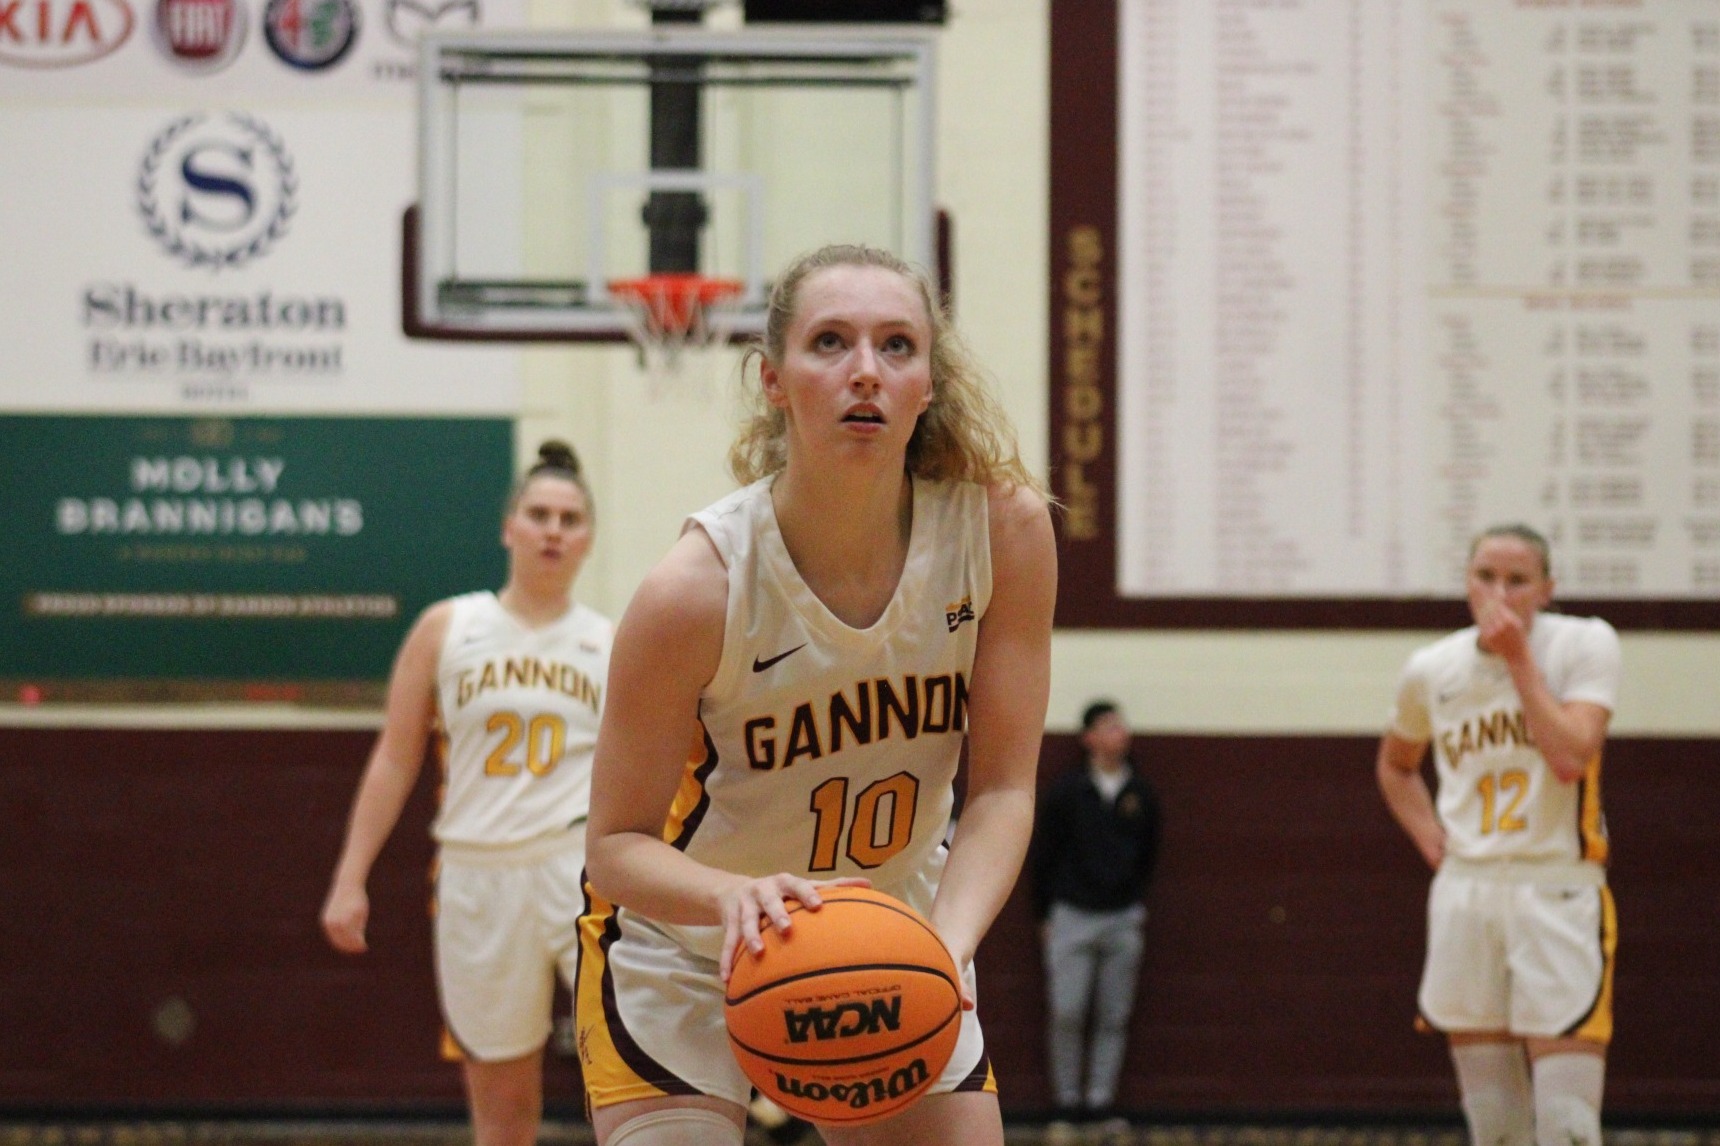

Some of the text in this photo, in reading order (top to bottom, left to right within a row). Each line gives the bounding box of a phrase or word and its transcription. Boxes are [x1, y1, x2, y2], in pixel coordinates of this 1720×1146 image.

[84, 287, 346, 330] Sheraton
[131, 459, 284, 491] MOLLY
[458, 657, 599, 714] GANNON
[485, 710, 566, 777] 20
[745, 671, 969, 770] GANNON
[1440, 711, 1528, 769] GANN
[808, 770, 920, 872] 10
[1477, 770, 1530, 835] 12
[784, 996, 902, 1043] NCAA
[775, 1058, 930, 1108] Wilson
